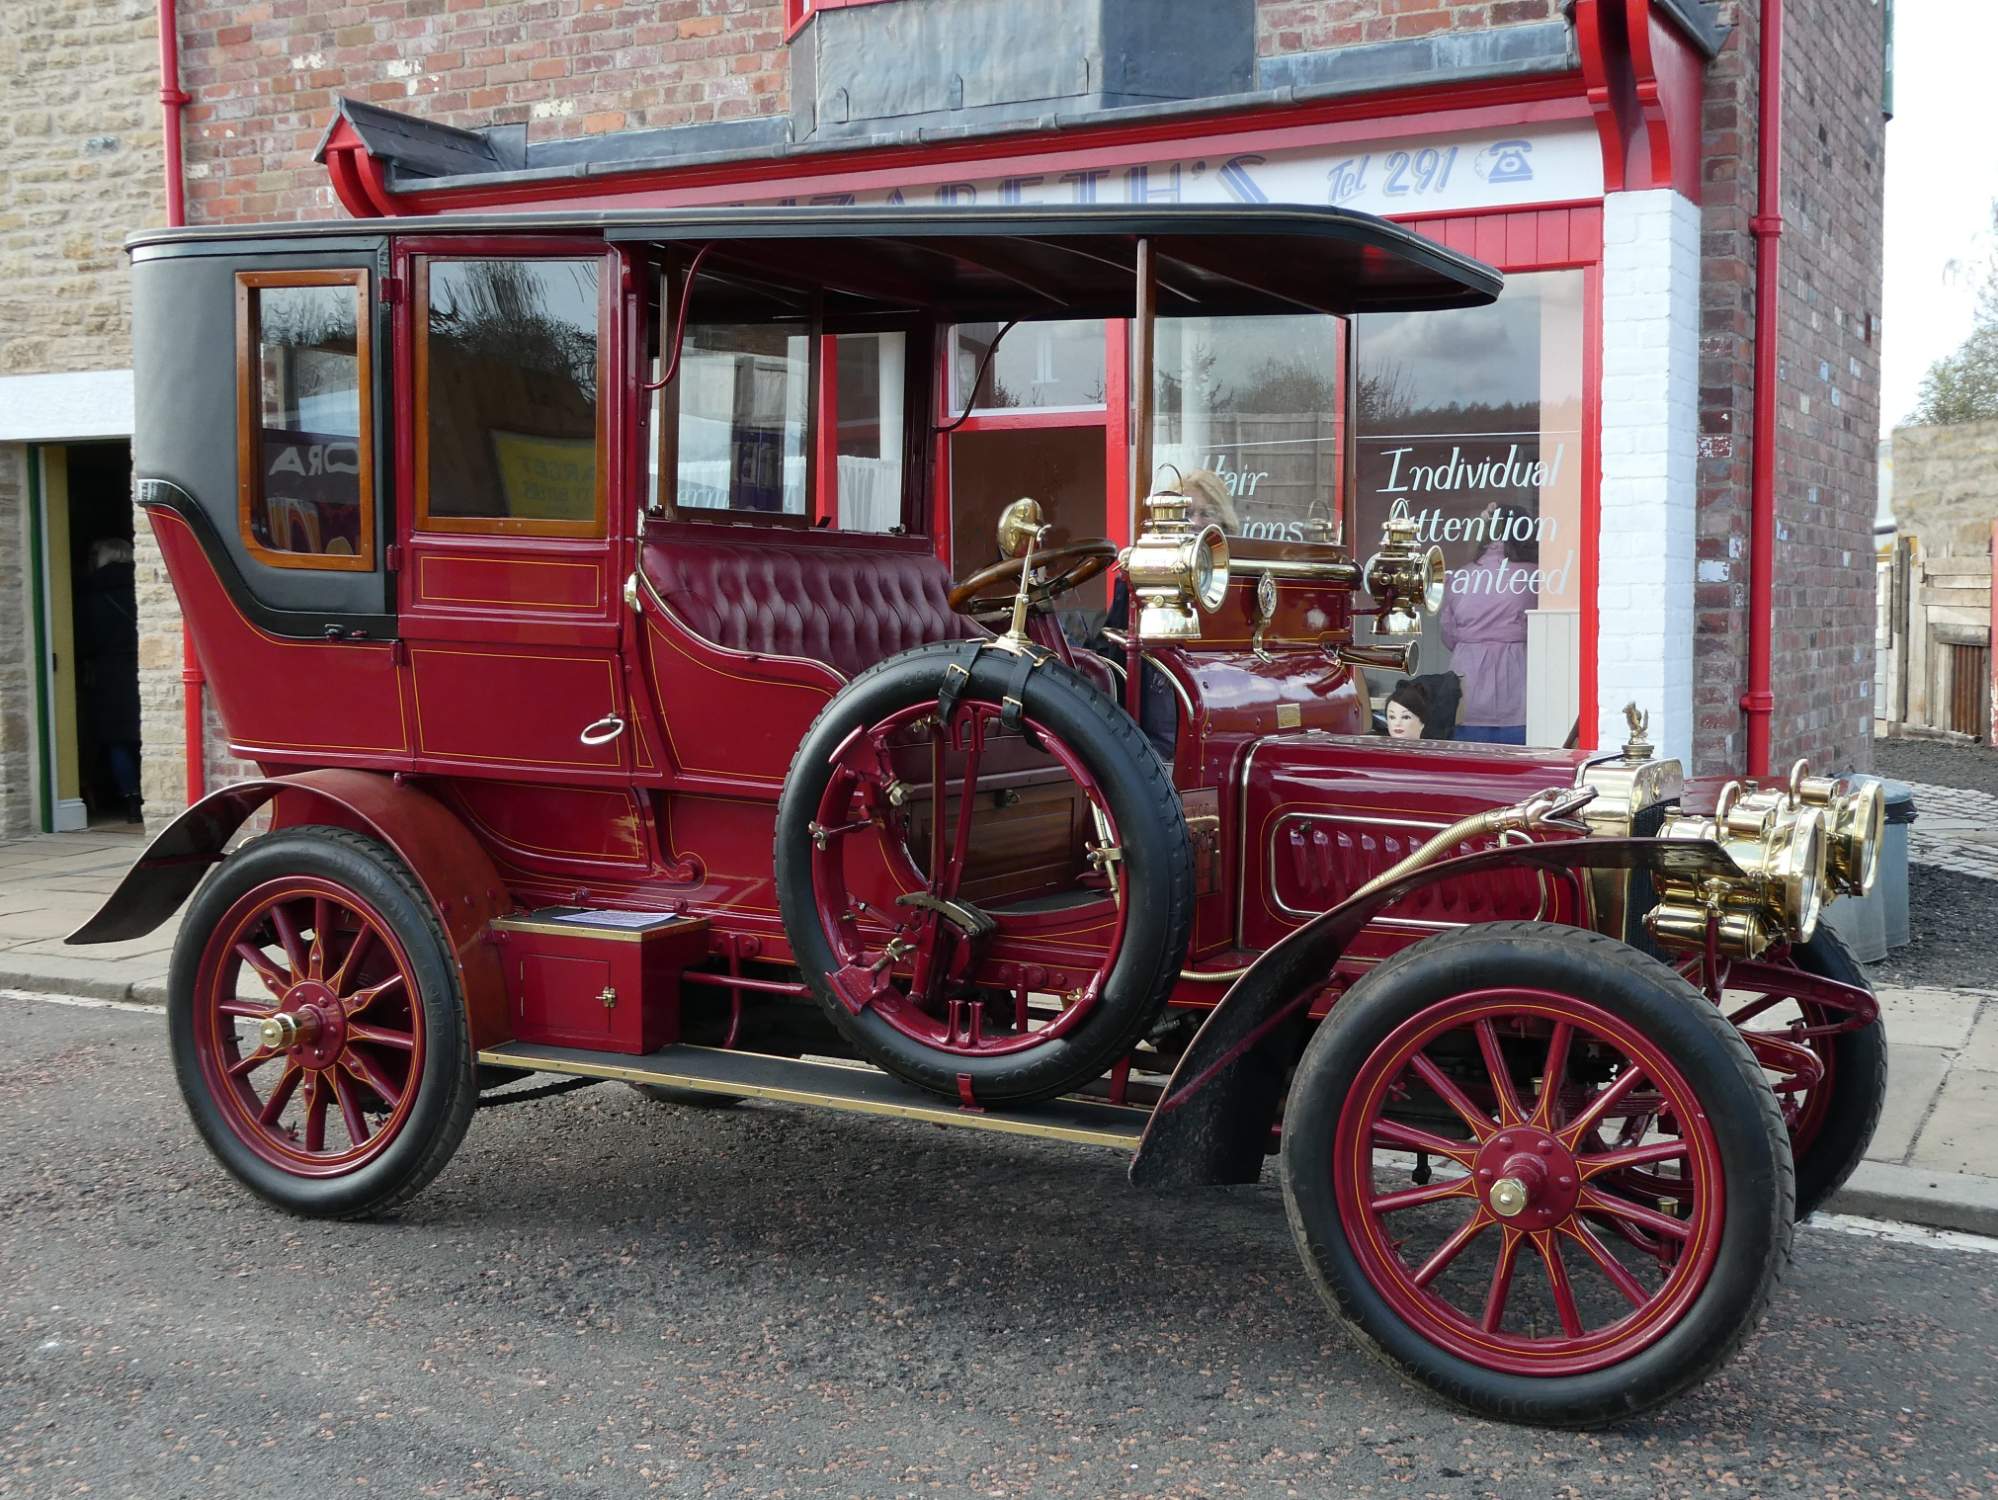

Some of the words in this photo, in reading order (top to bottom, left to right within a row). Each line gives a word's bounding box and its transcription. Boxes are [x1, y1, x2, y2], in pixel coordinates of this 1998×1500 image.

[1327, 154, 1371, 204] Tel
[1383, 145, 1458, 196] 291
[1376, 443, 1565, 493] Individual
